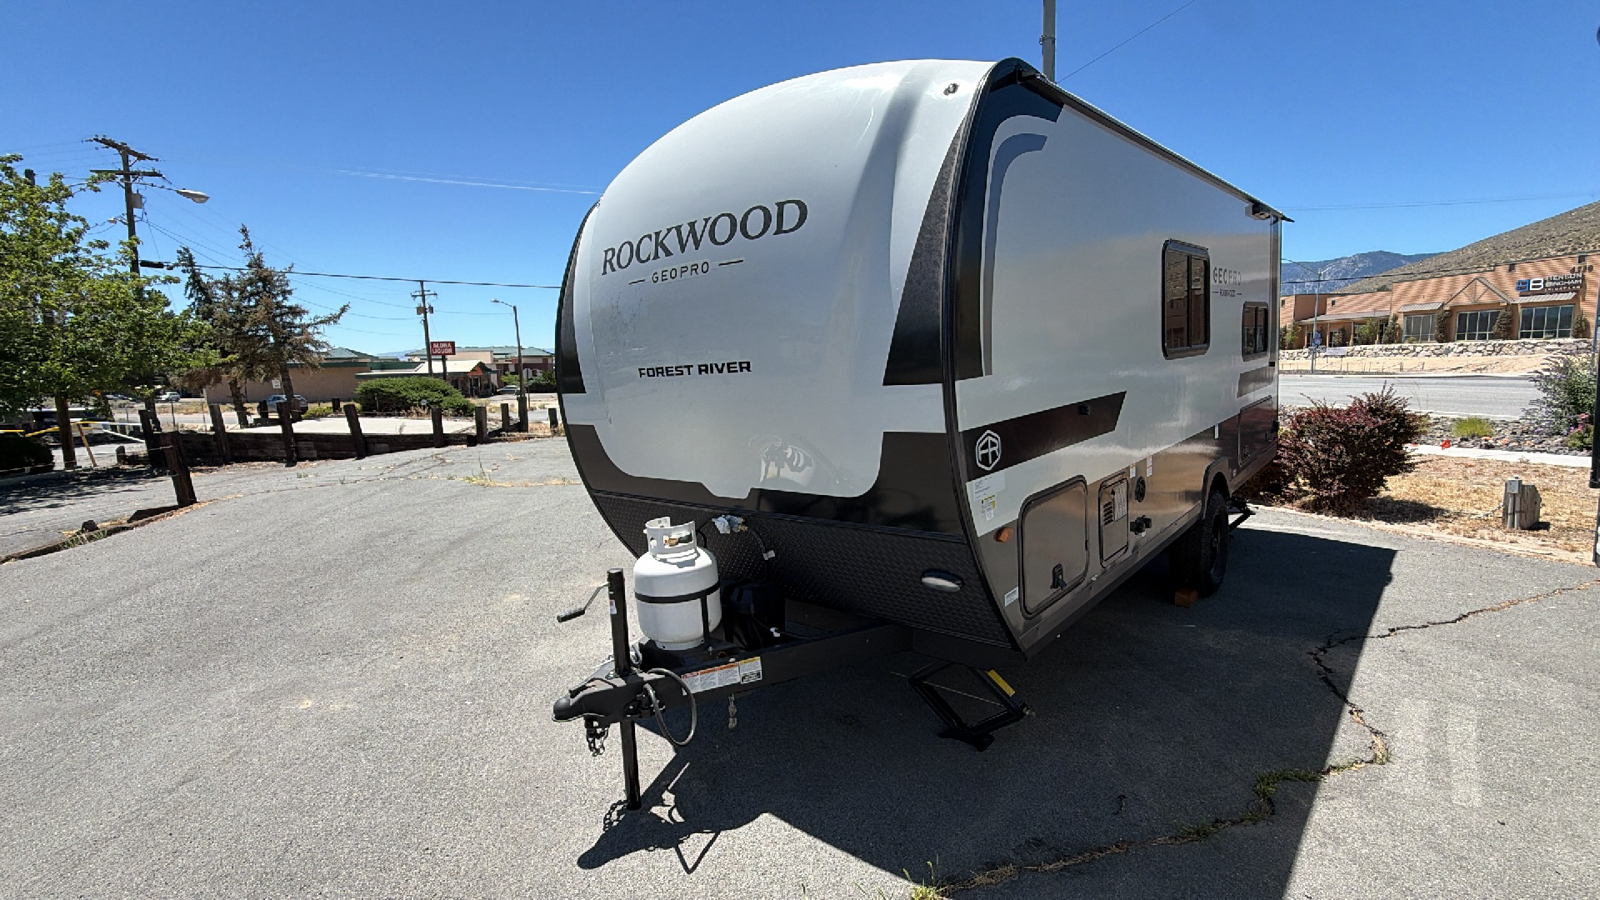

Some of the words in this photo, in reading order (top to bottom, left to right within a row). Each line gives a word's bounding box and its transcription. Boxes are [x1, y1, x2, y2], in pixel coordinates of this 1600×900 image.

[601, 199, 809, 276] ROCKWOOD
[651, 261, 710, 284] GEOPRO
[638, 364, 694, 378] FOREST
[697, 361, 752, 375] RIVER
